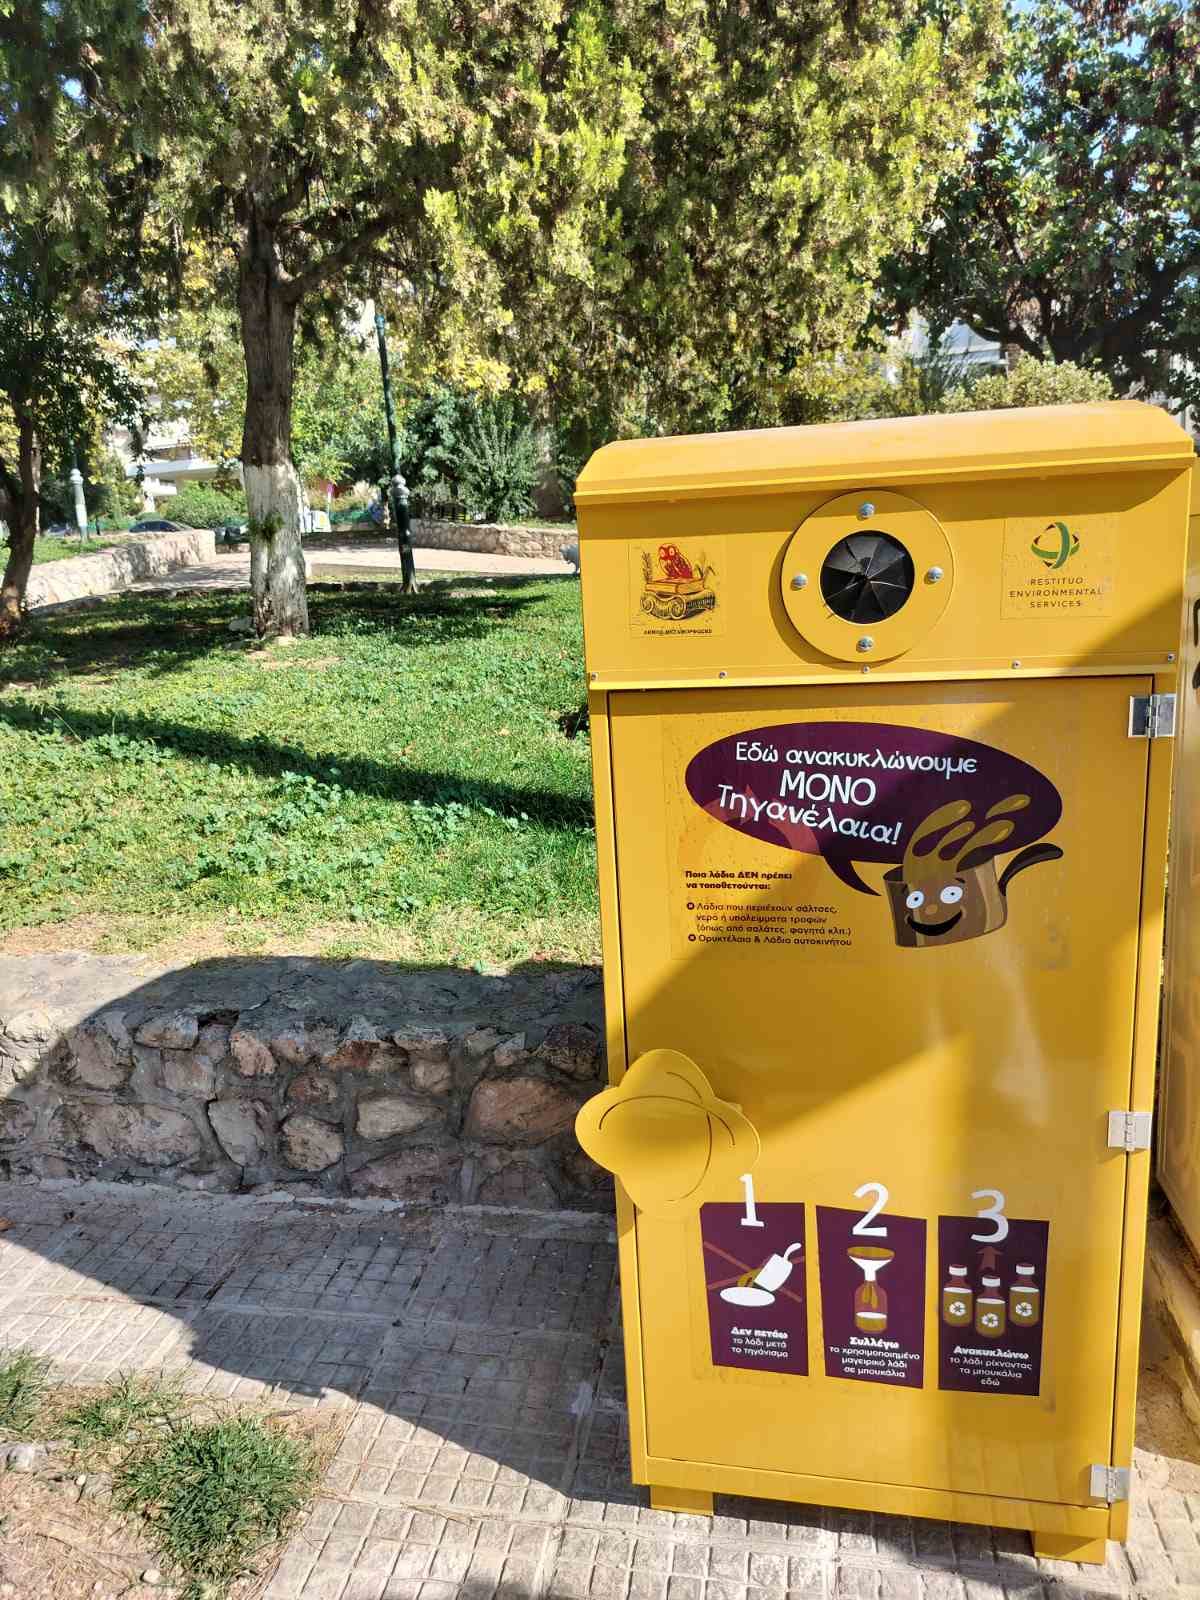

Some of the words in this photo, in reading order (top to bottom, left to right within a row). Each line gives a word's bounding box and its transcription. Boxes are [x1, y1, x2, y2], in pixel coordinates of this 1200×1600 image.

[1030, 577, 1084, 586] RESTITUO
[1009, 588, 1103, 598] ENVIRONMENTAL
[1030, 600, 1081, 608] SERVICES
[736, 742, 778, 762] Εδώ
[786, 749, 978, 780] ανακυκλώνουμε
[779, 769, 876, 806] ΜΟΝΟ
[717, 784, 902, 845] Τηγανέλαια!
[685, 870, 706, 878] Ποια
[709, 870, 736, 879] λάδια
[738, 871, 758, 879] ΔΕΝ
[761, 871, 792, 880] πρέπει
[700, 881, 770, 890] τοποθετούνται:
[696, 902, 724, 911] Λάδια
[696, 914, 718, 923] νερό
[726, 924, 744, 932] από
[698, 934, 752, 944] Ορυκτέλαια
[764, 936, 792, 944] Λάδια
[794, 937, 852, 946] αυτοκινήτου
[739, 1173, 765, 1227] 1
[852, 1182, 889, 1237] 2
[970, 1189, 1009, 1243] 3
[730, 1326, 752, 1336] Δεν
[745, 1337, 764, 1346] λάδι
[766, 1340, 786, 1348] μετά
[849, 1336, 900, 1350] Συλλέγω
[842, 1348, 920, 1360] χρησιμοποιημένο
[953, 1345, 1030, 1360] Ανακυκλώνω
[842, 1357, 886, 1367] μαγειρικό
[888, 1359, 908, 1369] λάδι
[962, 1356, 983, 1366] λάδι
[985, 1360, 1033, 1370] ρίχνοντας
[857, 1368, 906, 1378] μπουκάλια
[972, 1368, 1022, 1378] μπουκάλια
[980, 1377, 1000, 1386] εδώ
